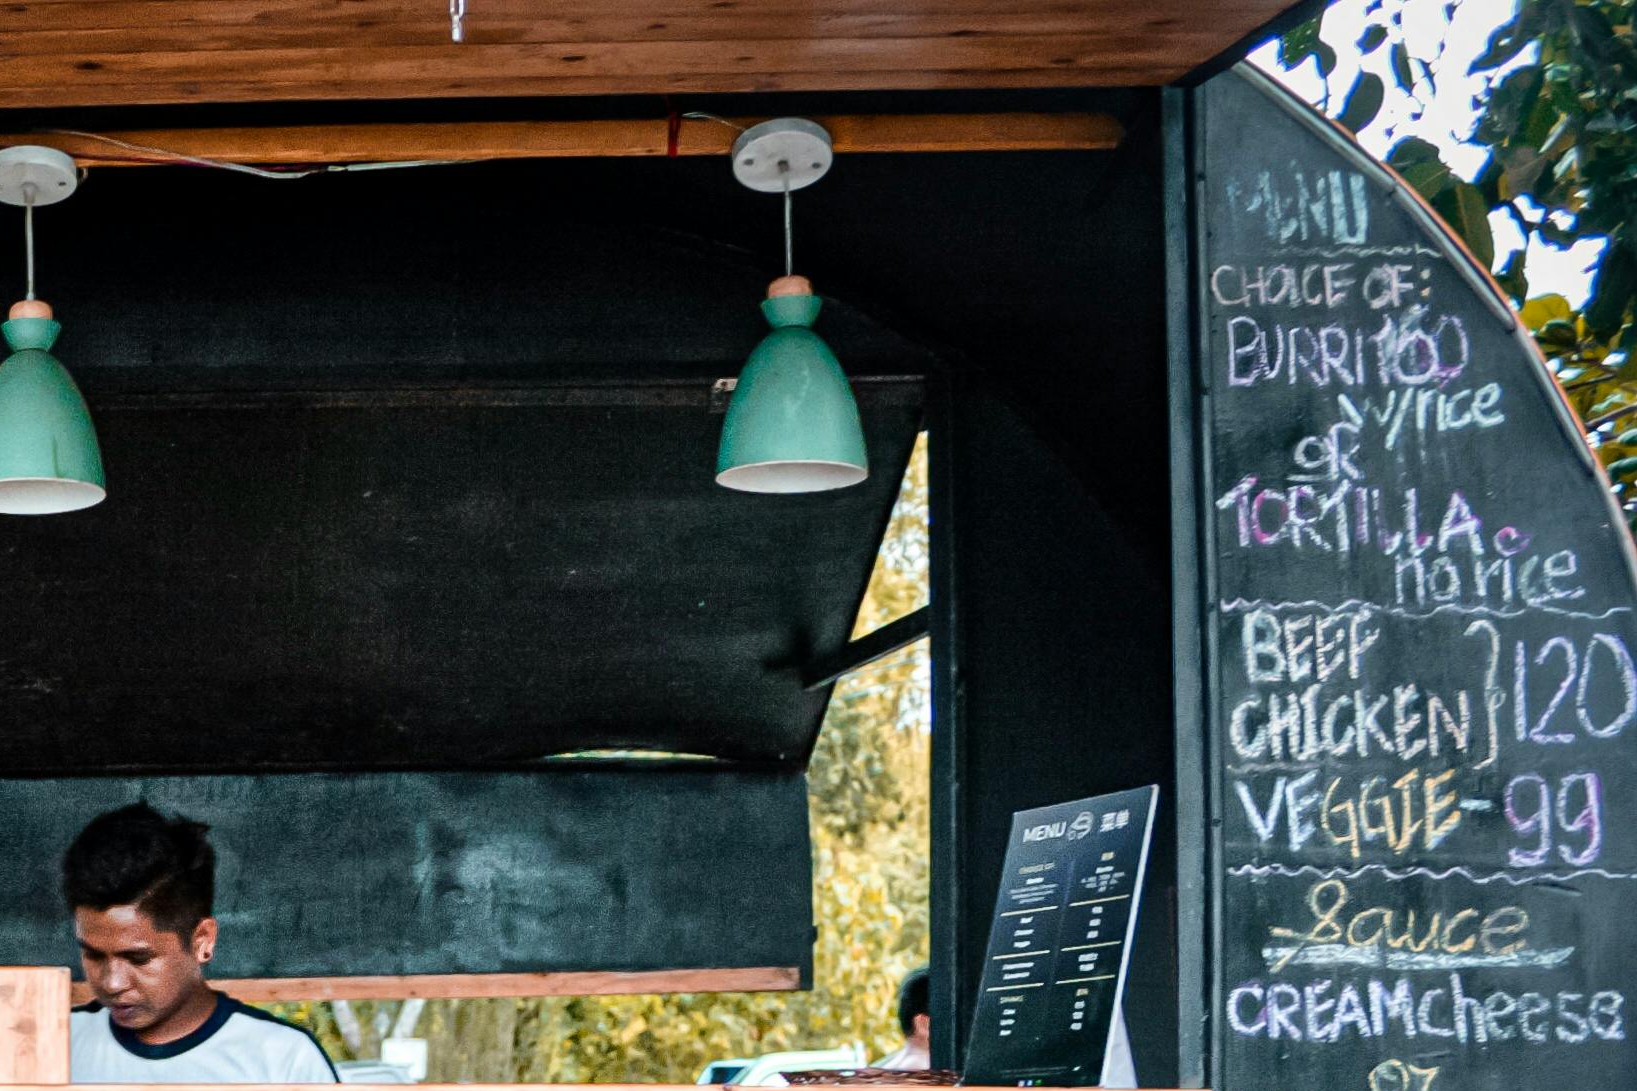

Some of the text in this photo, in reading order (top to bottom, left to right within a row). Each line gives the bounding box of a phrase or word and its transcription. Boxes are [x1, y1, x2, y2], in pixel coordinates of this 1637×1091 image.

[1212, 264, 1354, 307] CHOICE
[1216, 474, 1486, 557] TORTILLA
[1241, 610, 1380, 683] BEEF
[1230, 633, 1637, 762] CHICKEN 120
[1023, 821, 1067, 842] MENU
